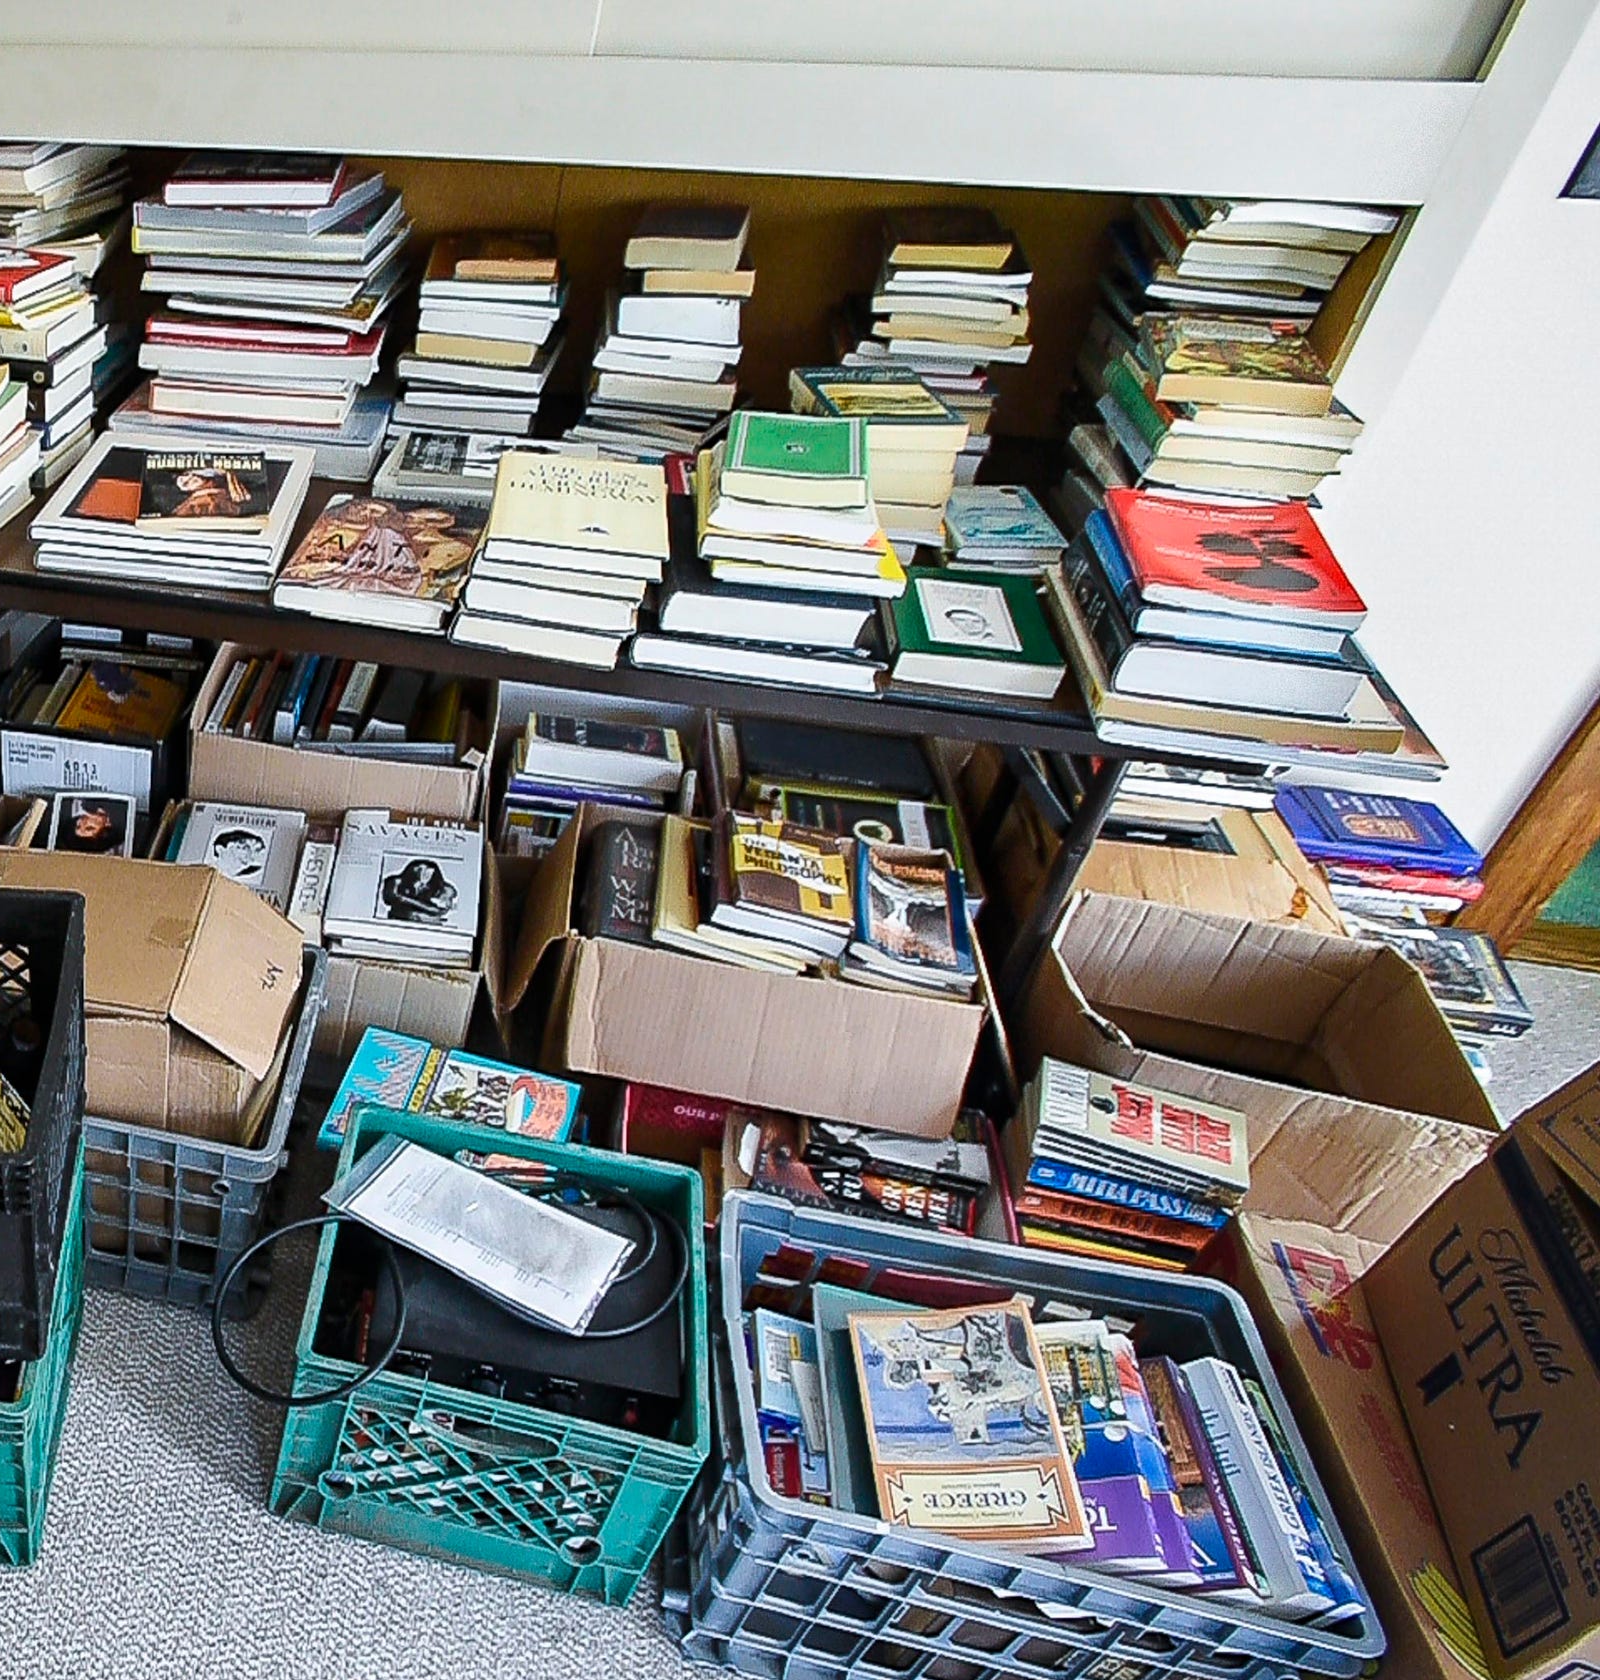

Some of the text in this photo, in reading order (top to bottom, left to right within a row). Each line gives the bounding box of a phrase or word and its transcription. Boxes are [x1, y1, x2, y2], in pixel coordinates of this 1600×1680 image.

[348, 822, 467, 842] SAVAGES
[1128, 1189, 1185, 1217] PASS
[1478, 1226, 1575, 1385] Michelob
[1428, 1223, 1544, 1471] ULTRA
[922, 1489, 1027, 1509] GREECE
[1264, 1469, 1302, 1533] GREEK
[1553, 1498, 1598, 1597] BOTTLES
